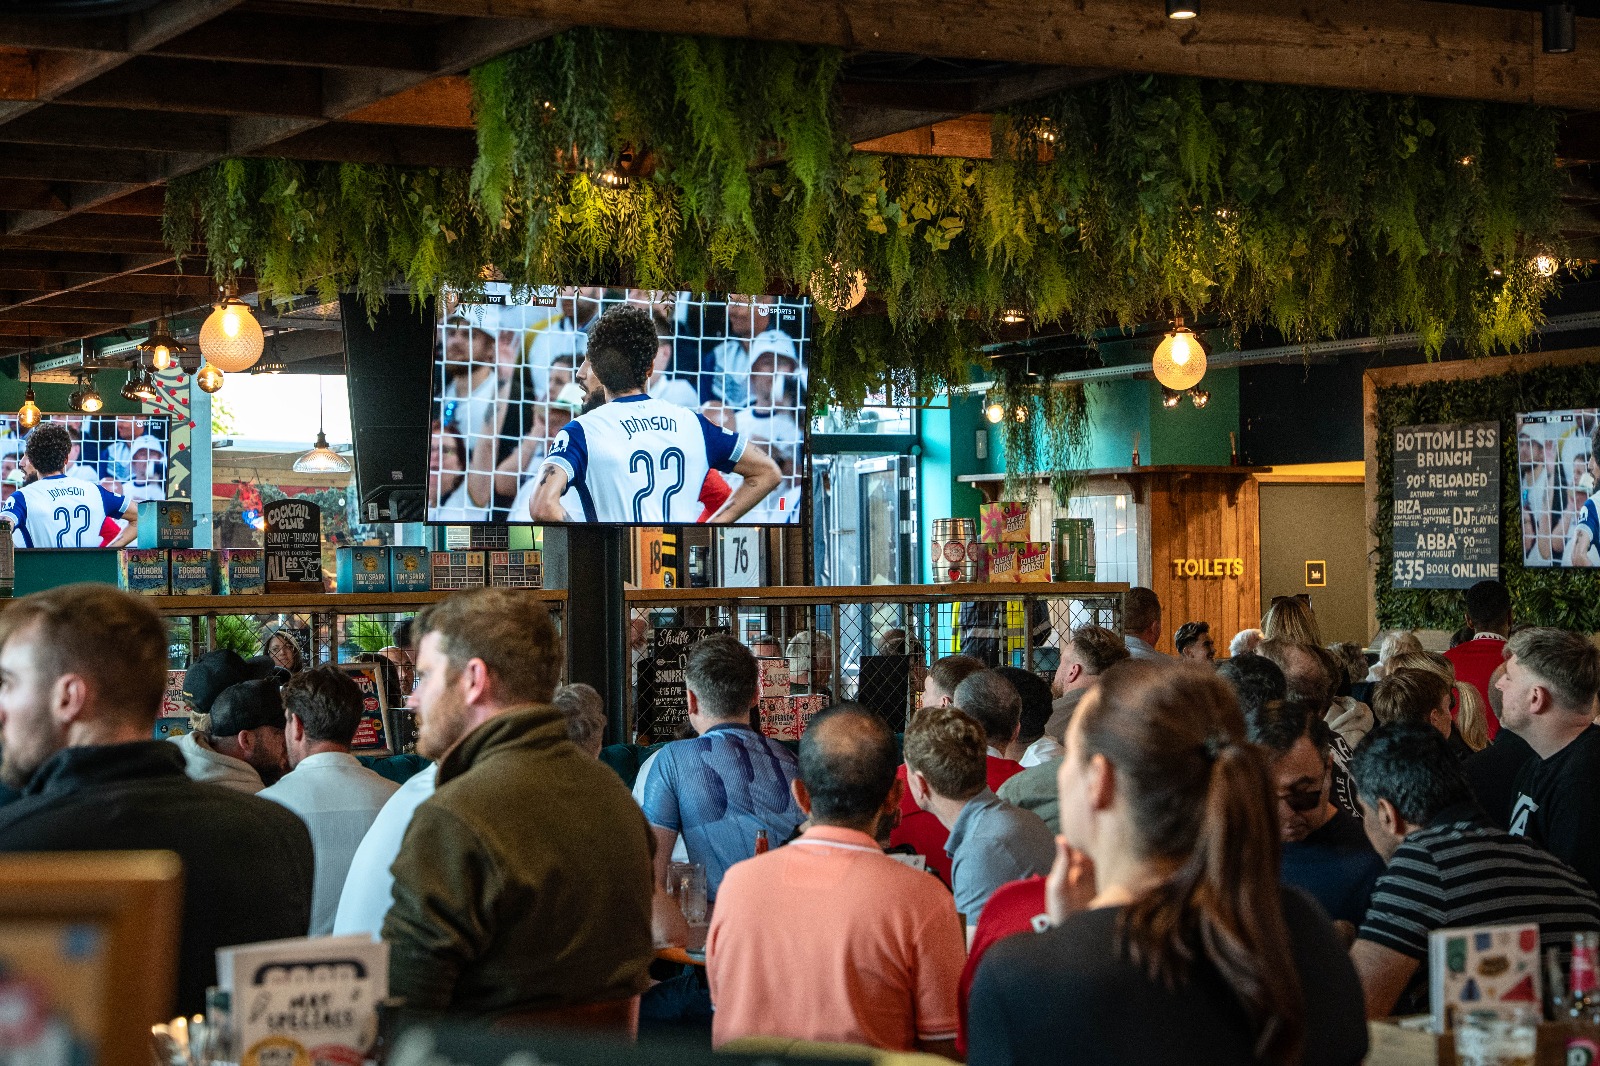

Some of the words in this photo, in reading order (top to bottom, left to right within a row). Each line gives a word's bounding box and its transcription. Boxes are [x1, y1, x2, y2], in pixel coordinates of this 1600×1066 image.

[1396, 428, 1496, 451] BOTTOMLESS
[1417, 451, 1472, 468] BRUNCH
[629, 447, 685, 522] 22
[1429, 472, 1488, 488] RELOADED
[268, 504, 310, 525] COCKTAIL
[1394, 500, 1421, 514] IBIZA
[279, 518, 304, 530] CLUB
[1453, 507, 1474, 526] DJ
[1472, 515, 1498, 525] PLAYING
[54, 504, 90, 548] 22
[1416, 533, 1457, 550] ABBA
[1464, 536, 1475, 548] 90
[650, 540, 661, 574] 18
[732, 536, 748, 574] 76
[134, 566, 162, 574] FOGHORN
[267, 556, 290, 580] ALL
[286, 557, 298, 568] £6
[1020, 560, 1044, 574] COAST
[1174, 558, 1244, 576] TOILETS
[1394, 560, 1424, 580] £35
[1426, 564, 1450, 574] BOOK
[1452, 564, 1498, 578] ONLINE
